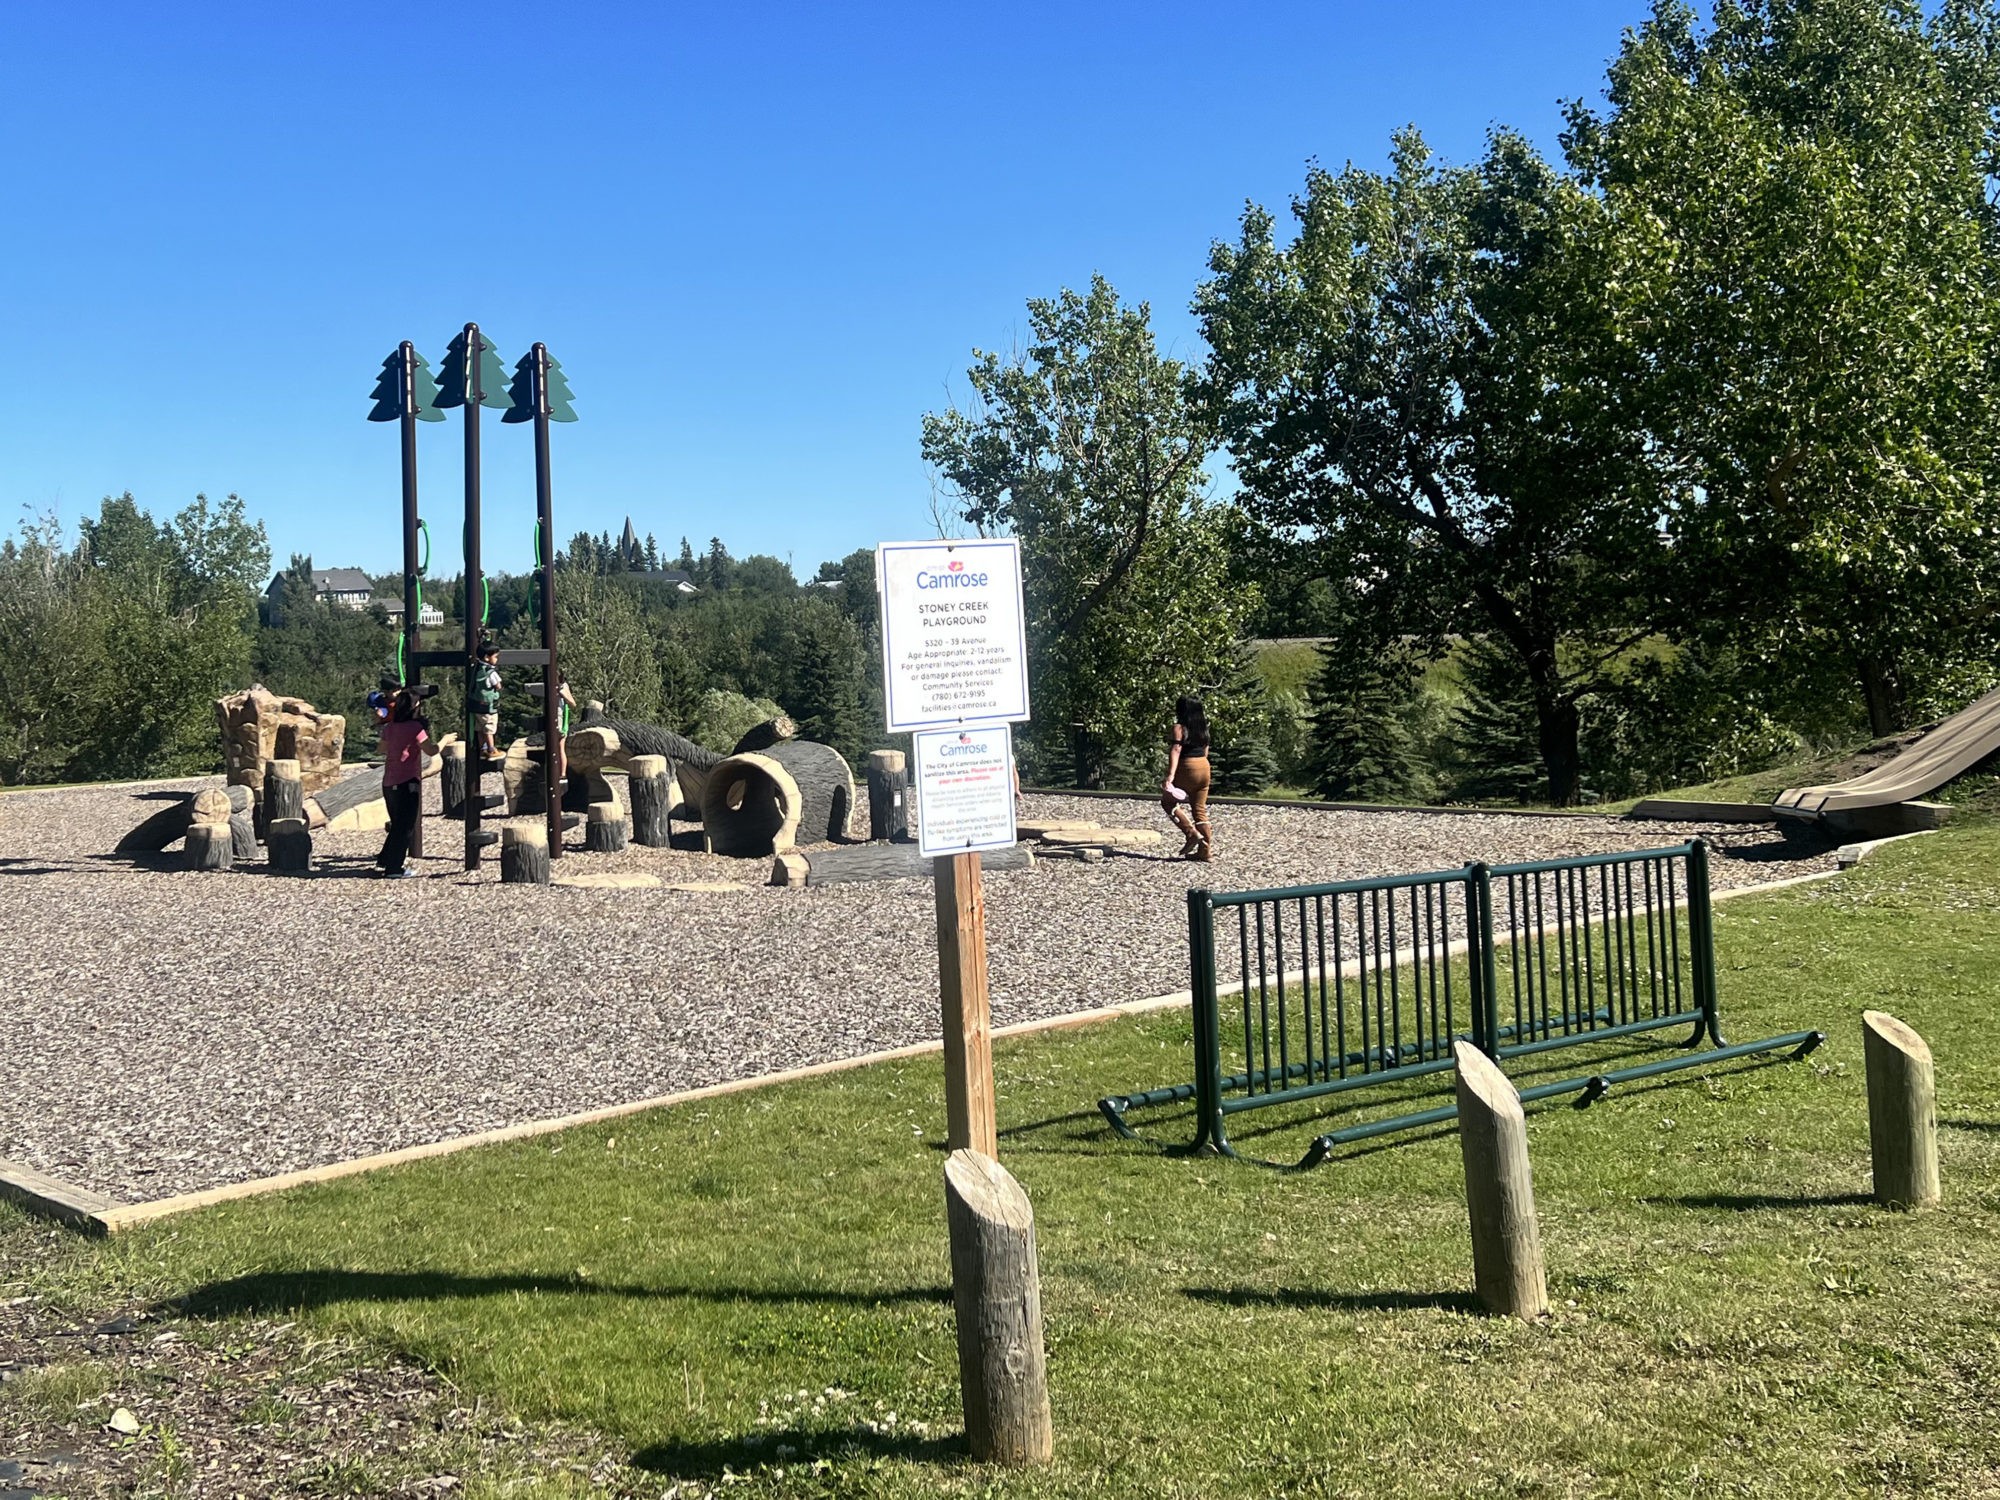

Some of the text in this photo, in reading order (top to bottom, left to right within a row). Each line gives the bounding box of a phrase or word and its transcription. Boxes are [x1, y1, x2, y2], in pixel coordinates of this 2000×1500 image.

[917, 571, 988, 589] Camrose
[919, 601, 989, 614] STONEY CREEK
[923, 615, 987, 627] PLAYGROUND
[924, 639, 943, 648] 5320
[951, 638, 960, 646] 39
[962, 637, 987, 645] Avenue
[907, 651, 922, 660] Age
[970, 646, 985, 655] 2-12
[987, 647, 1005, 655] years
[901, 663, 913, 671] For
[915, 661, 942, 671] general
[977, 656, 1012, 666] vandalism
[921, 672, 949, 681] damage
[951, 670, 974, 679] please
[922, 679, 994, 692] Community Services
[931, 692, 952, 701] (780)
[939, 743, 988, 757] Camrose
